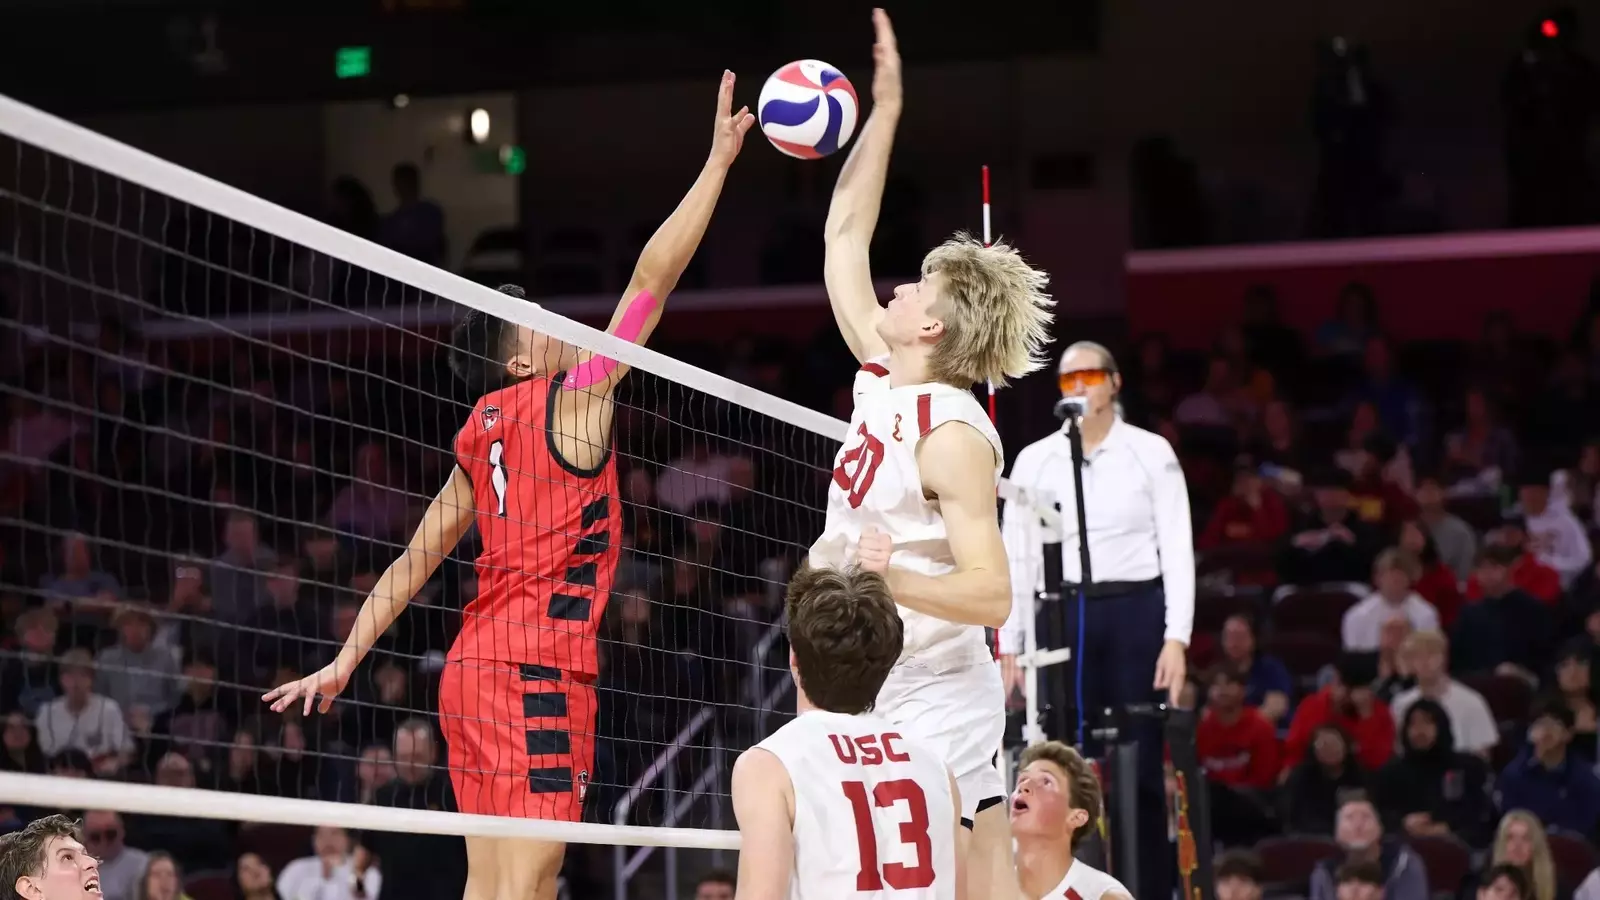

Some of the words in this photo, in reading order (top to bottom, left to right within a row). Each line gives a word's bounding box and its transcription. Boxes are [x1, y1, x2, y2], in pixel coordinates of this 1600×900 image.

[489, 438, 508, 517] 1
[828, 733, 911, 765] USC
[841, 779, 936, 891] 13
